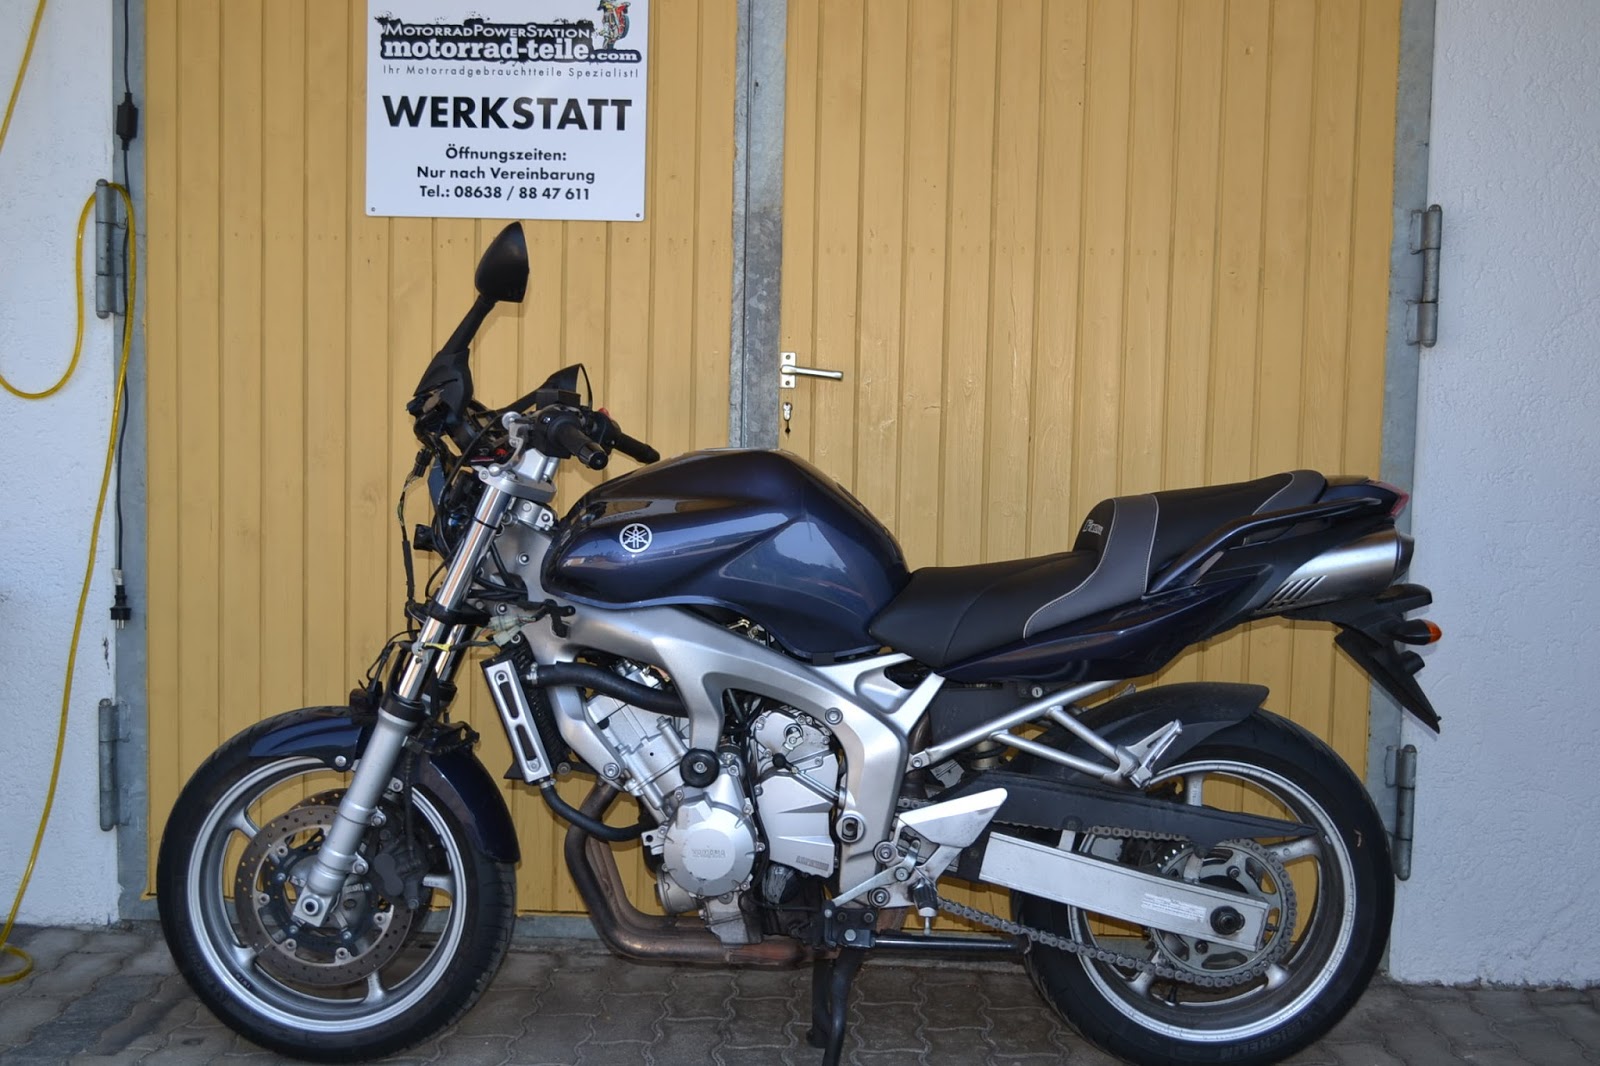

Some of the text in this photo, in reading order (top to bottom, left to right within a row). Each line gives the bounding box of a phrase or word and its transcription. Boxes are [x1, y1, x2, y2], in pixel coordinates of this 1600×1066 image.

[384, 39, 638, 61] motorrad-teile.com
[383, 65, 400, 75] Ihr
[406, 65, 562, 78] Motorradgebrauchtteile
[382, 95, 632, 130] WERKSTATT
[445, 144, 566, 163] Öffnungszeiten:
[417, 165, 595, 184] Nur nach Vereinbarung
[420, 185, 590, 201] Tel.: 08638 / 88 47 611
